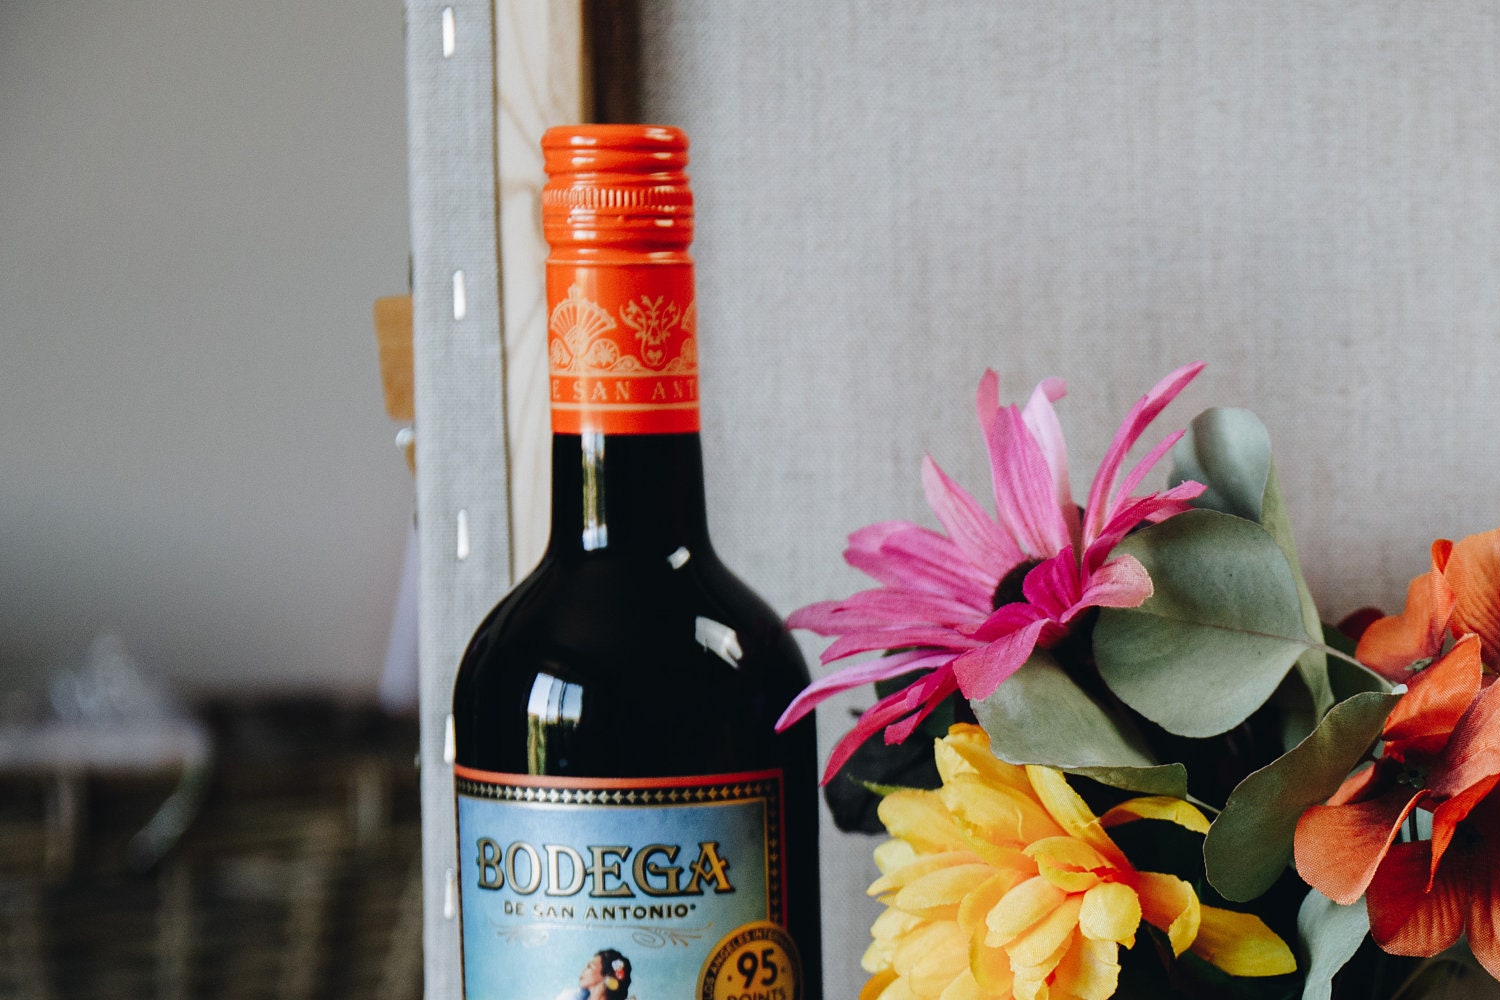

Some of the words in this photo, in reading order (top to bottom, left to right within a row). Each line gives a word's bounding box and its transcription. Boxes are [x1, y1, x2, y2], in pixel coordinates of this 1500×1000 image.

[572, 380, 631, 400] SAN
[475, 836, 736, 899] BODEGA
[503, 901, 525, 916] DE
[532, 902, 575, 919] SAN
[736, 948, 778, 990] 95
